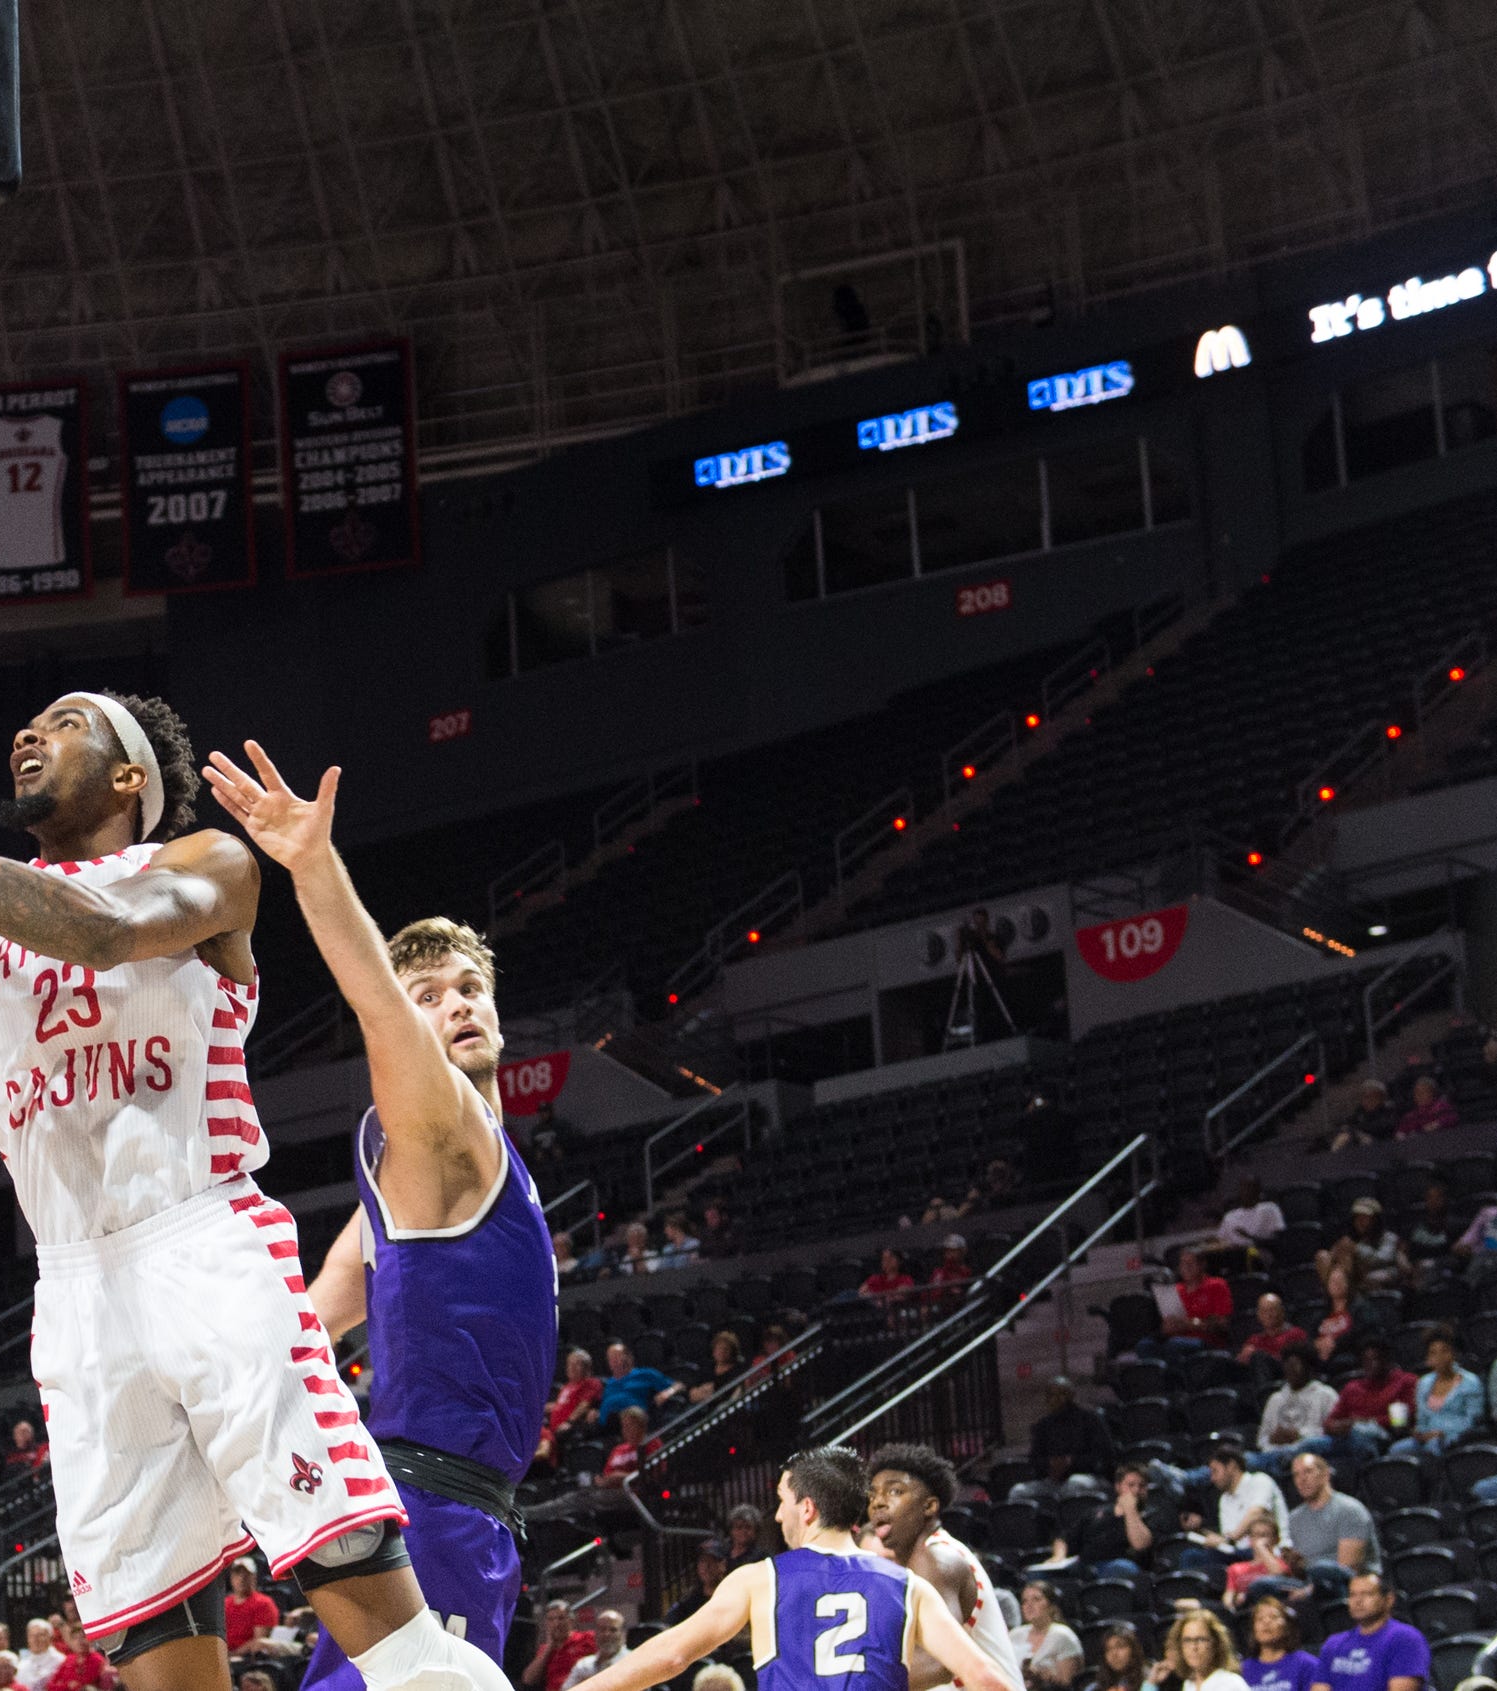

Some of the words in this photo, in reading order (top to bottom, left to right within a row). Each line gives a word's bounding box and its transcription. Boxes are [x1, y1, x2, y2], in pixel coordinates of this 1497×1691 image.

[1308, 294, 1384, 343] It's
[1389, 267, 1485, 320] time
[135, 447, 237, 470] TOURNAMENT
[295, 439, 403, 469] CHAMPIONS
[8, 461, 42, 493] 12
[137, 463, 235, 487] APPEARANCE
[147, 489, 229, 526] 2007
[959, 583, 1009, 614] 208
[429, 711, 470, 739] 207
[1099, 918, 1164, 963] 109
[33, 962, 102, 1044] 23
[6, 1035, 172, 1130] CAJUNS
[504, 1060, 552, 1098] 108
[814, 1591, 867, 1676] 2
